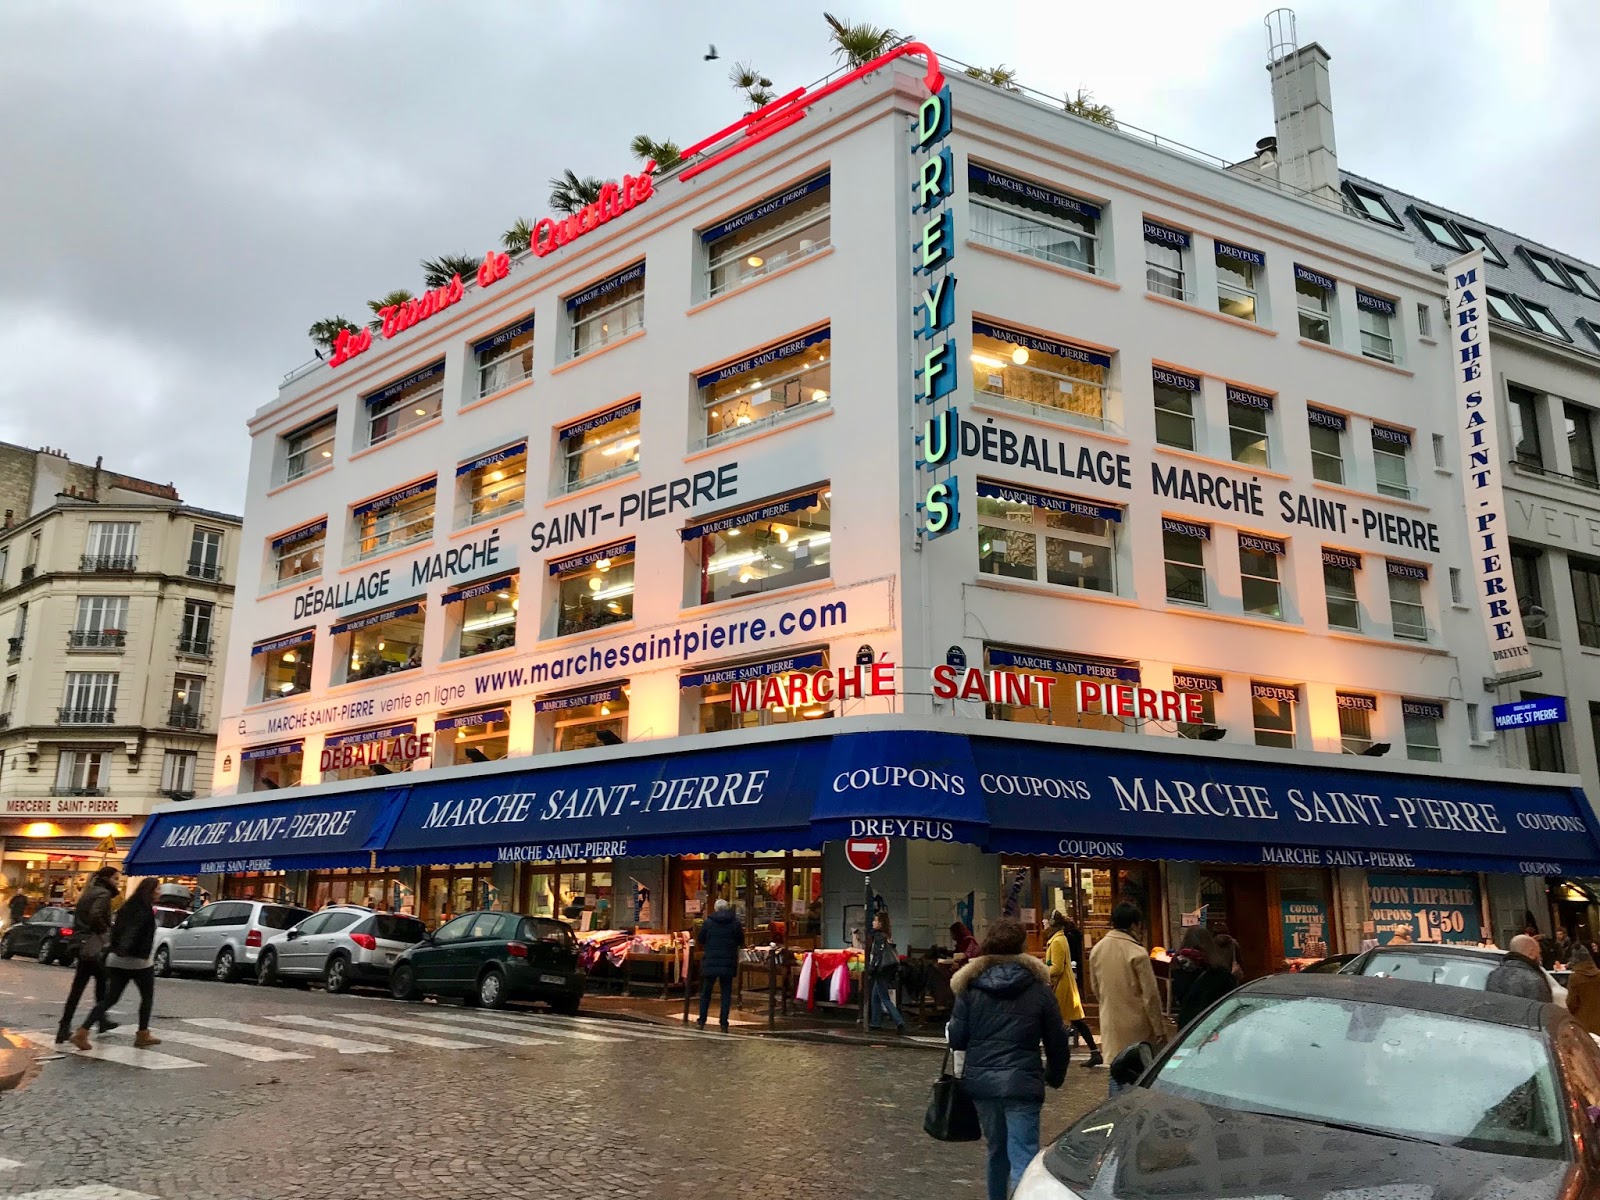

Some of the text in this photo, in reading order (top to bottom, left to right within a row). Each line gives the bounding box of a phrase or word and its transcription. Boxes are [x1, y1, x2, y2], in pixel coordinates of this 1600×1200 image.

[987, 173, 1081, 211] MARCHE SAINT PIERRE
[723, 185, 809, 233] MARCHE SAINT PIERRE
[1144, 223, 1185, 245] DREYFUS
[328, 159, 657, 368] Les Tissus de Qualité
[1219, 244, 1260, 263] DREYFUS
[575, 267, 642, 306] MARCHE SAINT PIERRE
[1298, 268, 1333, 289] DREYFUS
[1358, 293, 1392, 312] DREYFUS
[918, 94, 952, 533] DREYFUS
[1454, 267, 1482, 383] MARCHÉ
[493, 327, 522, 346] DREYFUS
[992, 328, 1089, 362] MARCHE SAINT PIERRE
[719, 339, 806, 379] MARCHE SAINT PIERRE
[1153, 369, 1196, 389] DREYFUS
[1229, 389, 1269, 408] DREYFUS
[568, 404, 636, 437] MARCHE SAINT PIERRE
[1307, 410, 1342, 428] DREYFUS
[1373, 427, 1408, 444] DREYFUS
[474, 452, 505, 469] DREYFUS
[960, 417, 1132, 490] DÉBALLAGE
[1151, 462, 1264, 517] MARCHÉ
[999, 488, 1100, 517] MARCHE SAINT PIERRE
[701, 502, 790, 535] MARCHE SAINT PIERRE
[1164, 521, 1207, 538] DREYFUS
[293, 461, 739, 620] DÉBALLAGE MARCHÉ SAINT-PIERRE
[1240, 536, 1281, 553] DREYFUS
[557, 543, 628, 572] MARCHE SAINT PIERRE
[1322, 552, 1357, 567] DREYFUS
[1388, 563, 1425, 578] DREYFUS
[461, 583, 491, 600] DREYFUS
[1492, 645, 1529, 661] DREYFUS
[267, 708, 307, 734] MARCHÉ
[309, 699, 375, 725] SAINT-PIERRE
[380, 694, 412, 713] vente
[415, 690, 431, 705] en
[434, 682, 466, 709] ligne
[475, 601, 847, 694] www.marchesaintpierre.com
[703, 659, 794, 684] MARCHE SAINT PIERRE
[1013, 655, 1117, 678] MARCHE SAINT PIERRE
[731, 652, 1204, 724] MARCHÉ SAINT PIERRE
[1173, 674, 1217, 690] DREYFUS
[1253, 684, 1296, 700] DREYFUS
[541, 691, 611, 711] MARCHE SAINT PIERRE
[1336, 695, 1373, 709] DREYFUS
[1404, 703, 1440, 717] DREYFUS
[454, 713, 483, 728] DREYFUS
[1495, 713, 1524, 726] MARCHE
[1533, 707, 1559, 721] PIERRE
[319, 732, 433, 773] DEBALLAGE
[832, 765, 966, 796] COUPONS
[6, 800, 119, 812] MERCERIE SAINT-PIERRE
[421, 769, 770, 829] MARCHE SAINT-PIERRE
[980, 773, 1587, 834] COUPONS MARCHE SAINT-PIERRE COUPONS
[160, 809, 357, 849] MARCHE SAINT-PIERRE
[850, 819, 954, 841] DREYFUS
[497, 840, 628, 862] MARCHE SAINT-PIERRE
[1058, 839, 1124, 856] COUPONS
[1262, 846, 1416, 868] MARCHE SAINT-PIERRE
[200, 861, 226, 873] MARCHE
[1519, 861, 1562, 875] COUPONS
[1290, 904, 1318, 913] COTON
